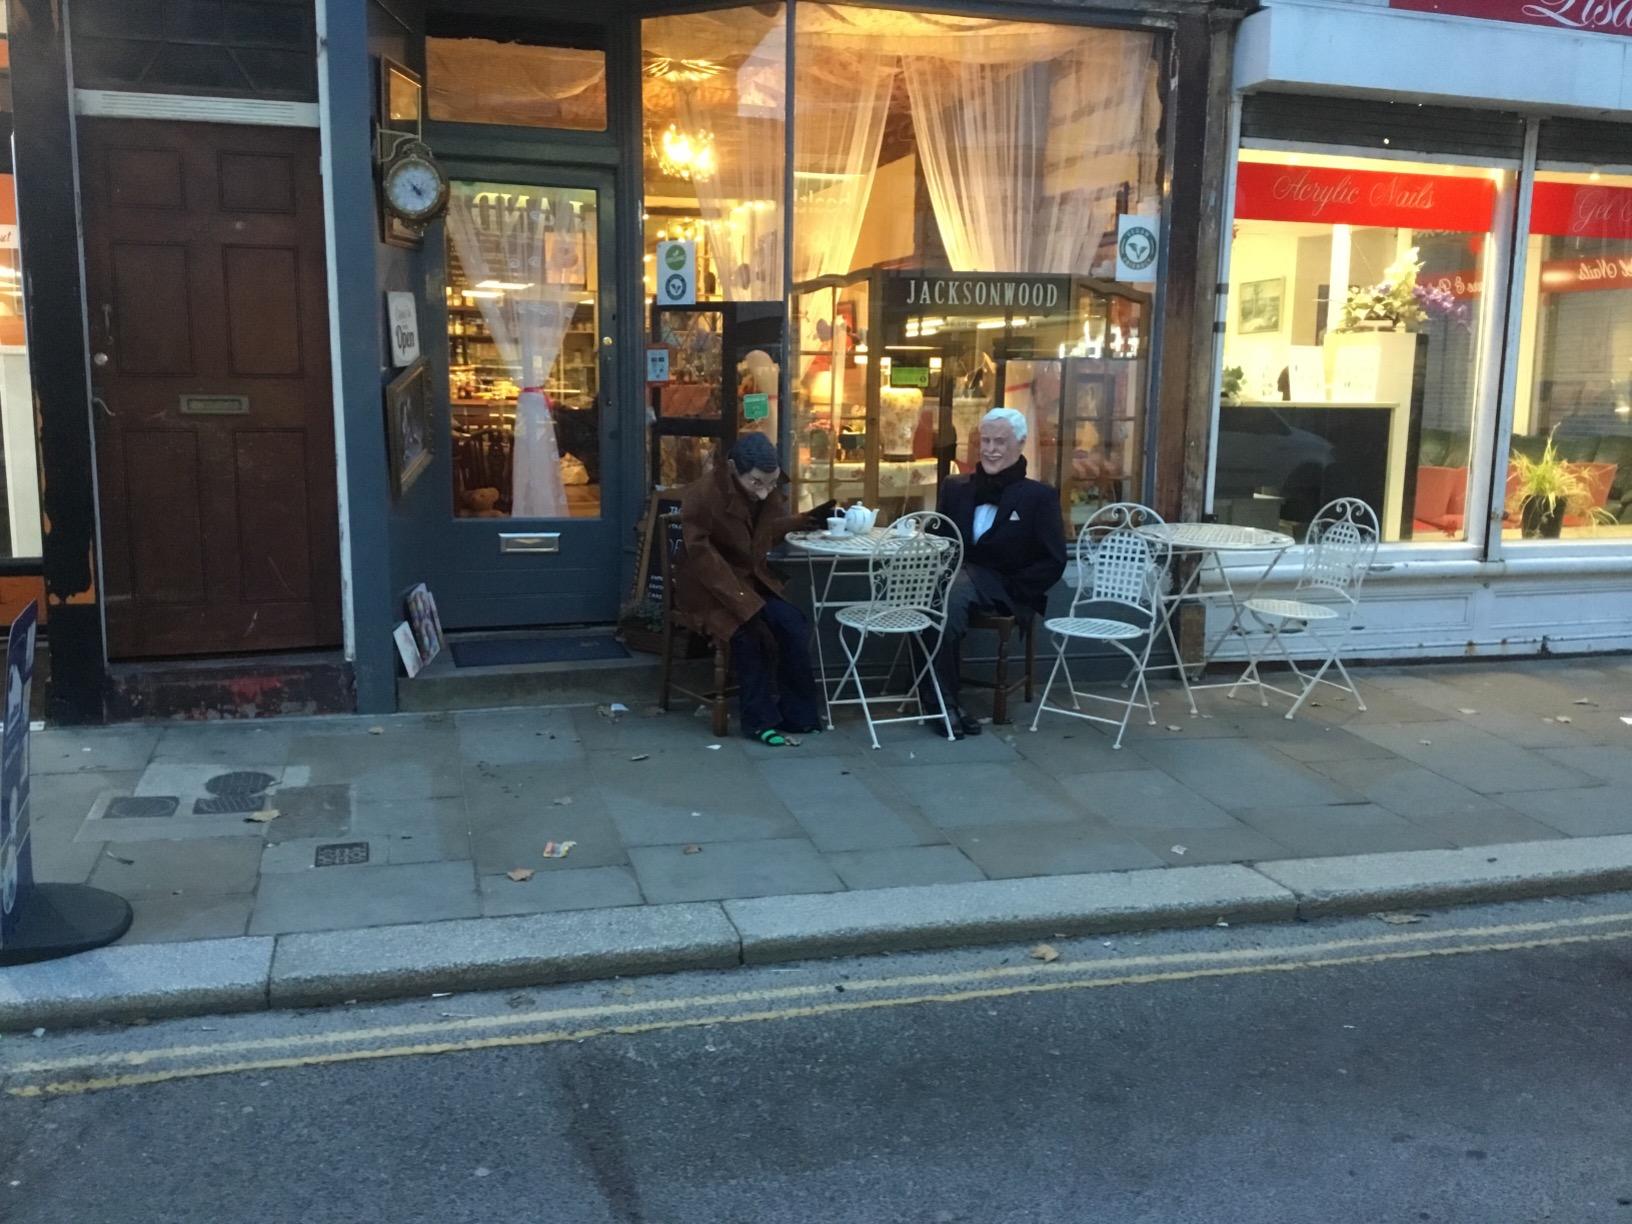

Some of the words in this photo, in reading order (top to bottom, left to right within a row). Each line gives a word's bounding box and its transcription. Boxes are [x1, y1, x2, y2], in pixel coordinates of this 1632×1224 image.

[1272, 170, 1360, 216] Acrylic
[1370, 176, 1435, 209] Nails
[906, 279, 1058, 308] JACKSONWOOD
[396, 325, 415, 357] Open
